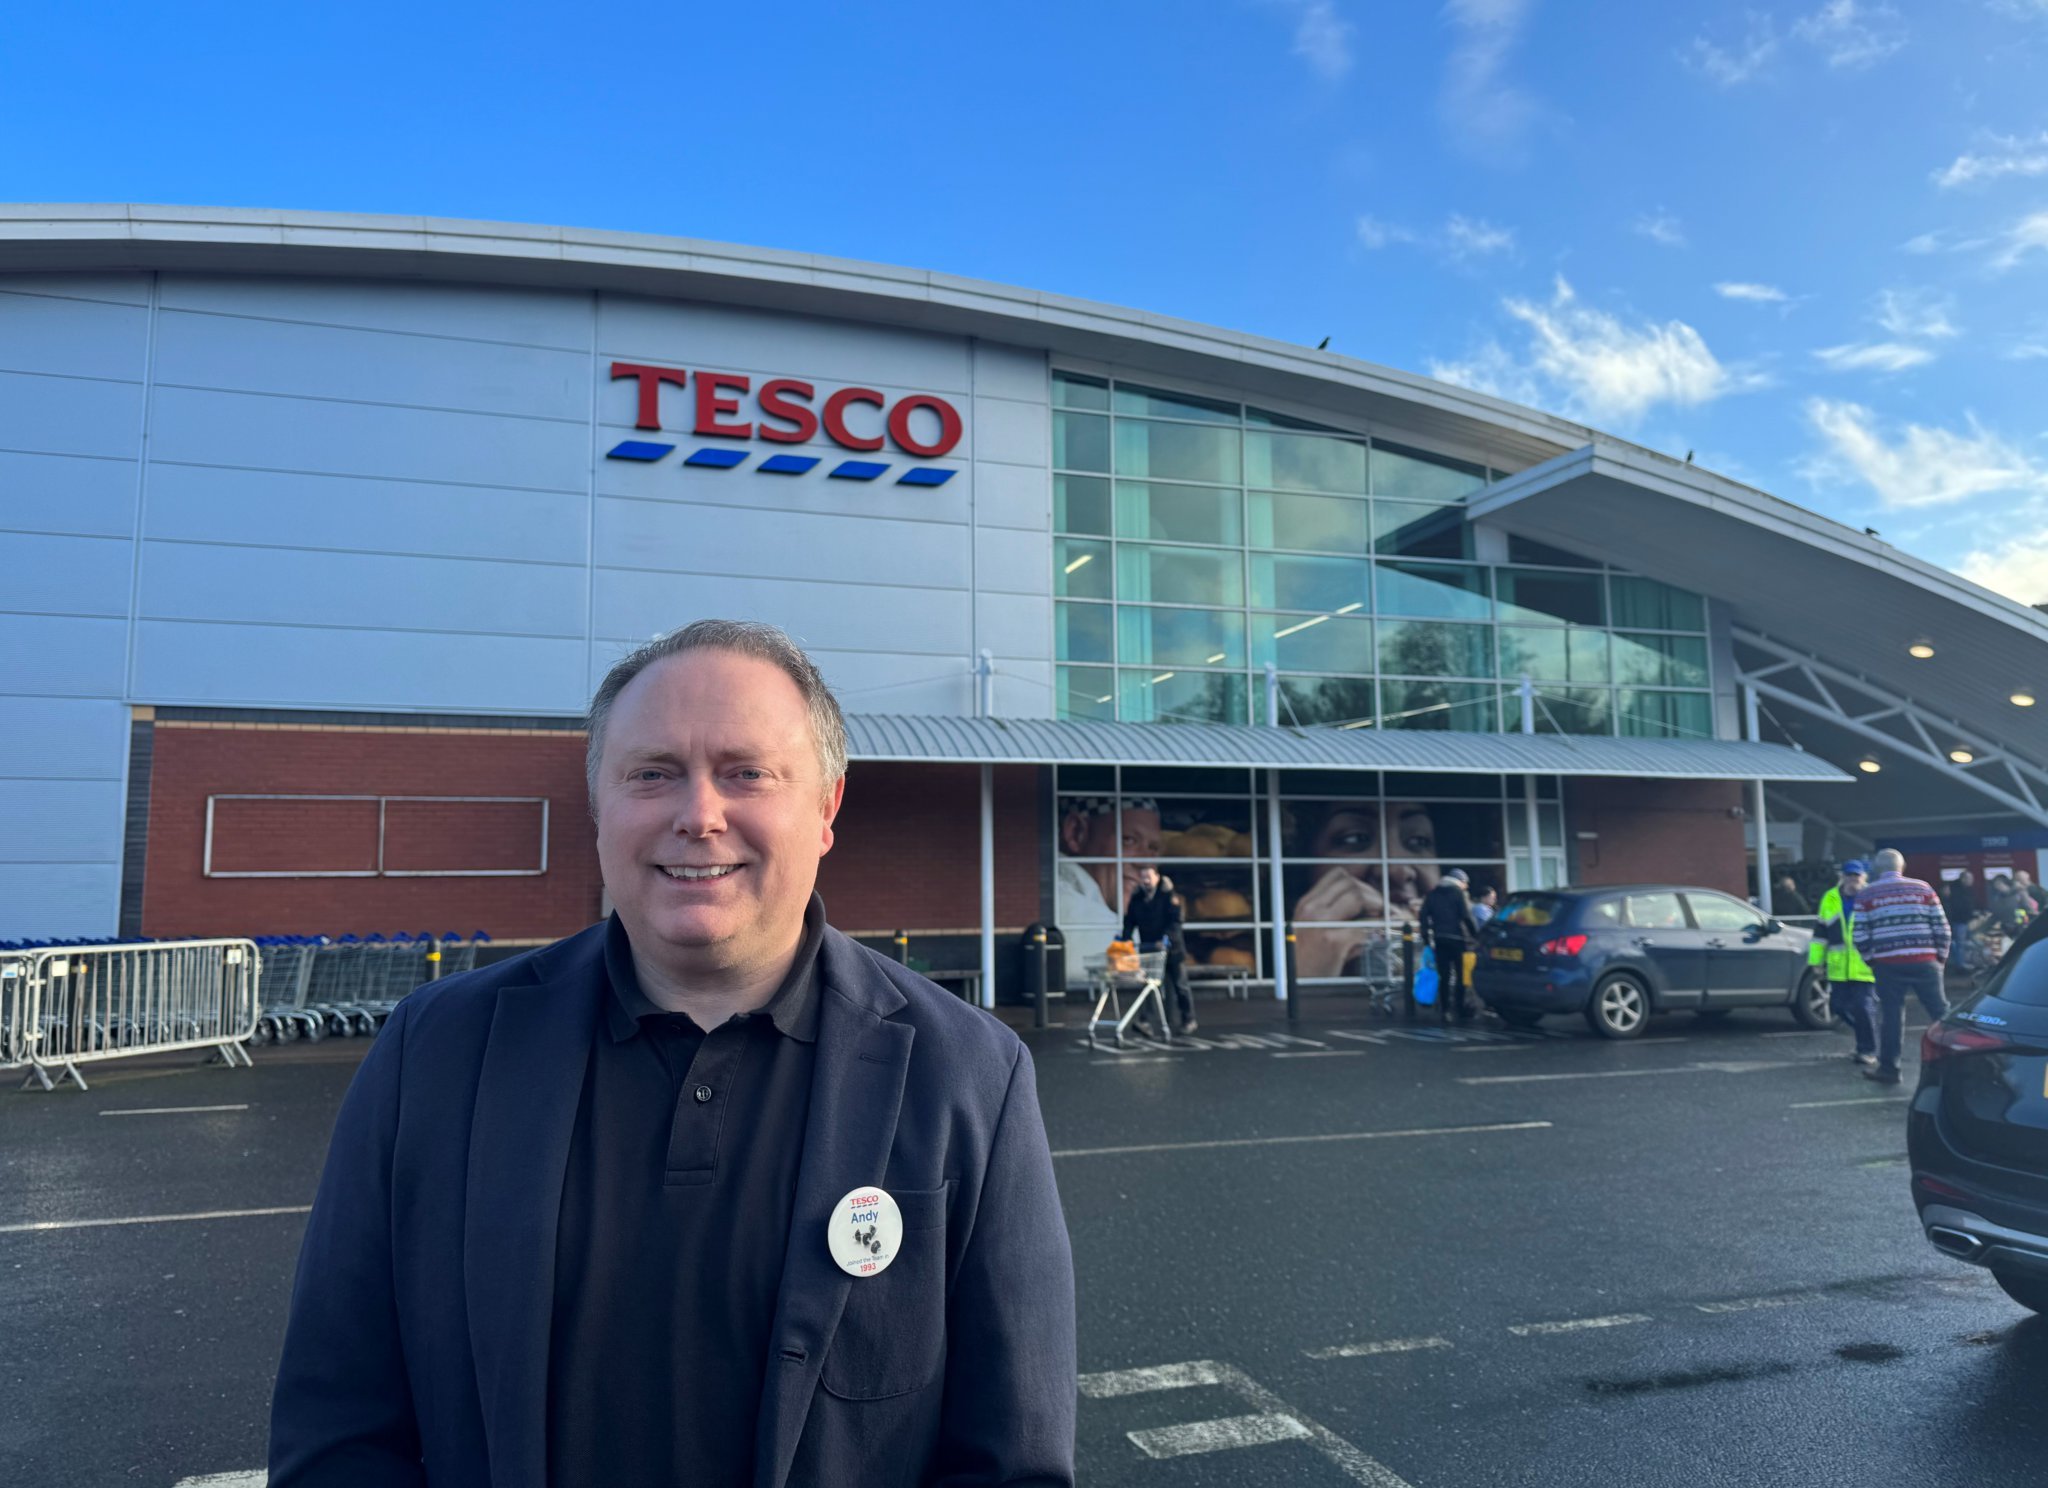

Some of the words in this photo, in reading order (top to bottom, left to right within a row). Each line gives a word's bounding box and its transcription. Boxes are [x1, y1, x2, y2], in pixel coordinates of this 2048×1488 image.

[611, 362, 963, 457] TESCO
[850, 1195, 879, 1206] TESCO
[851, 1210, 879, 1224] Andy
[860, 1263, 876, 1272] 1993
